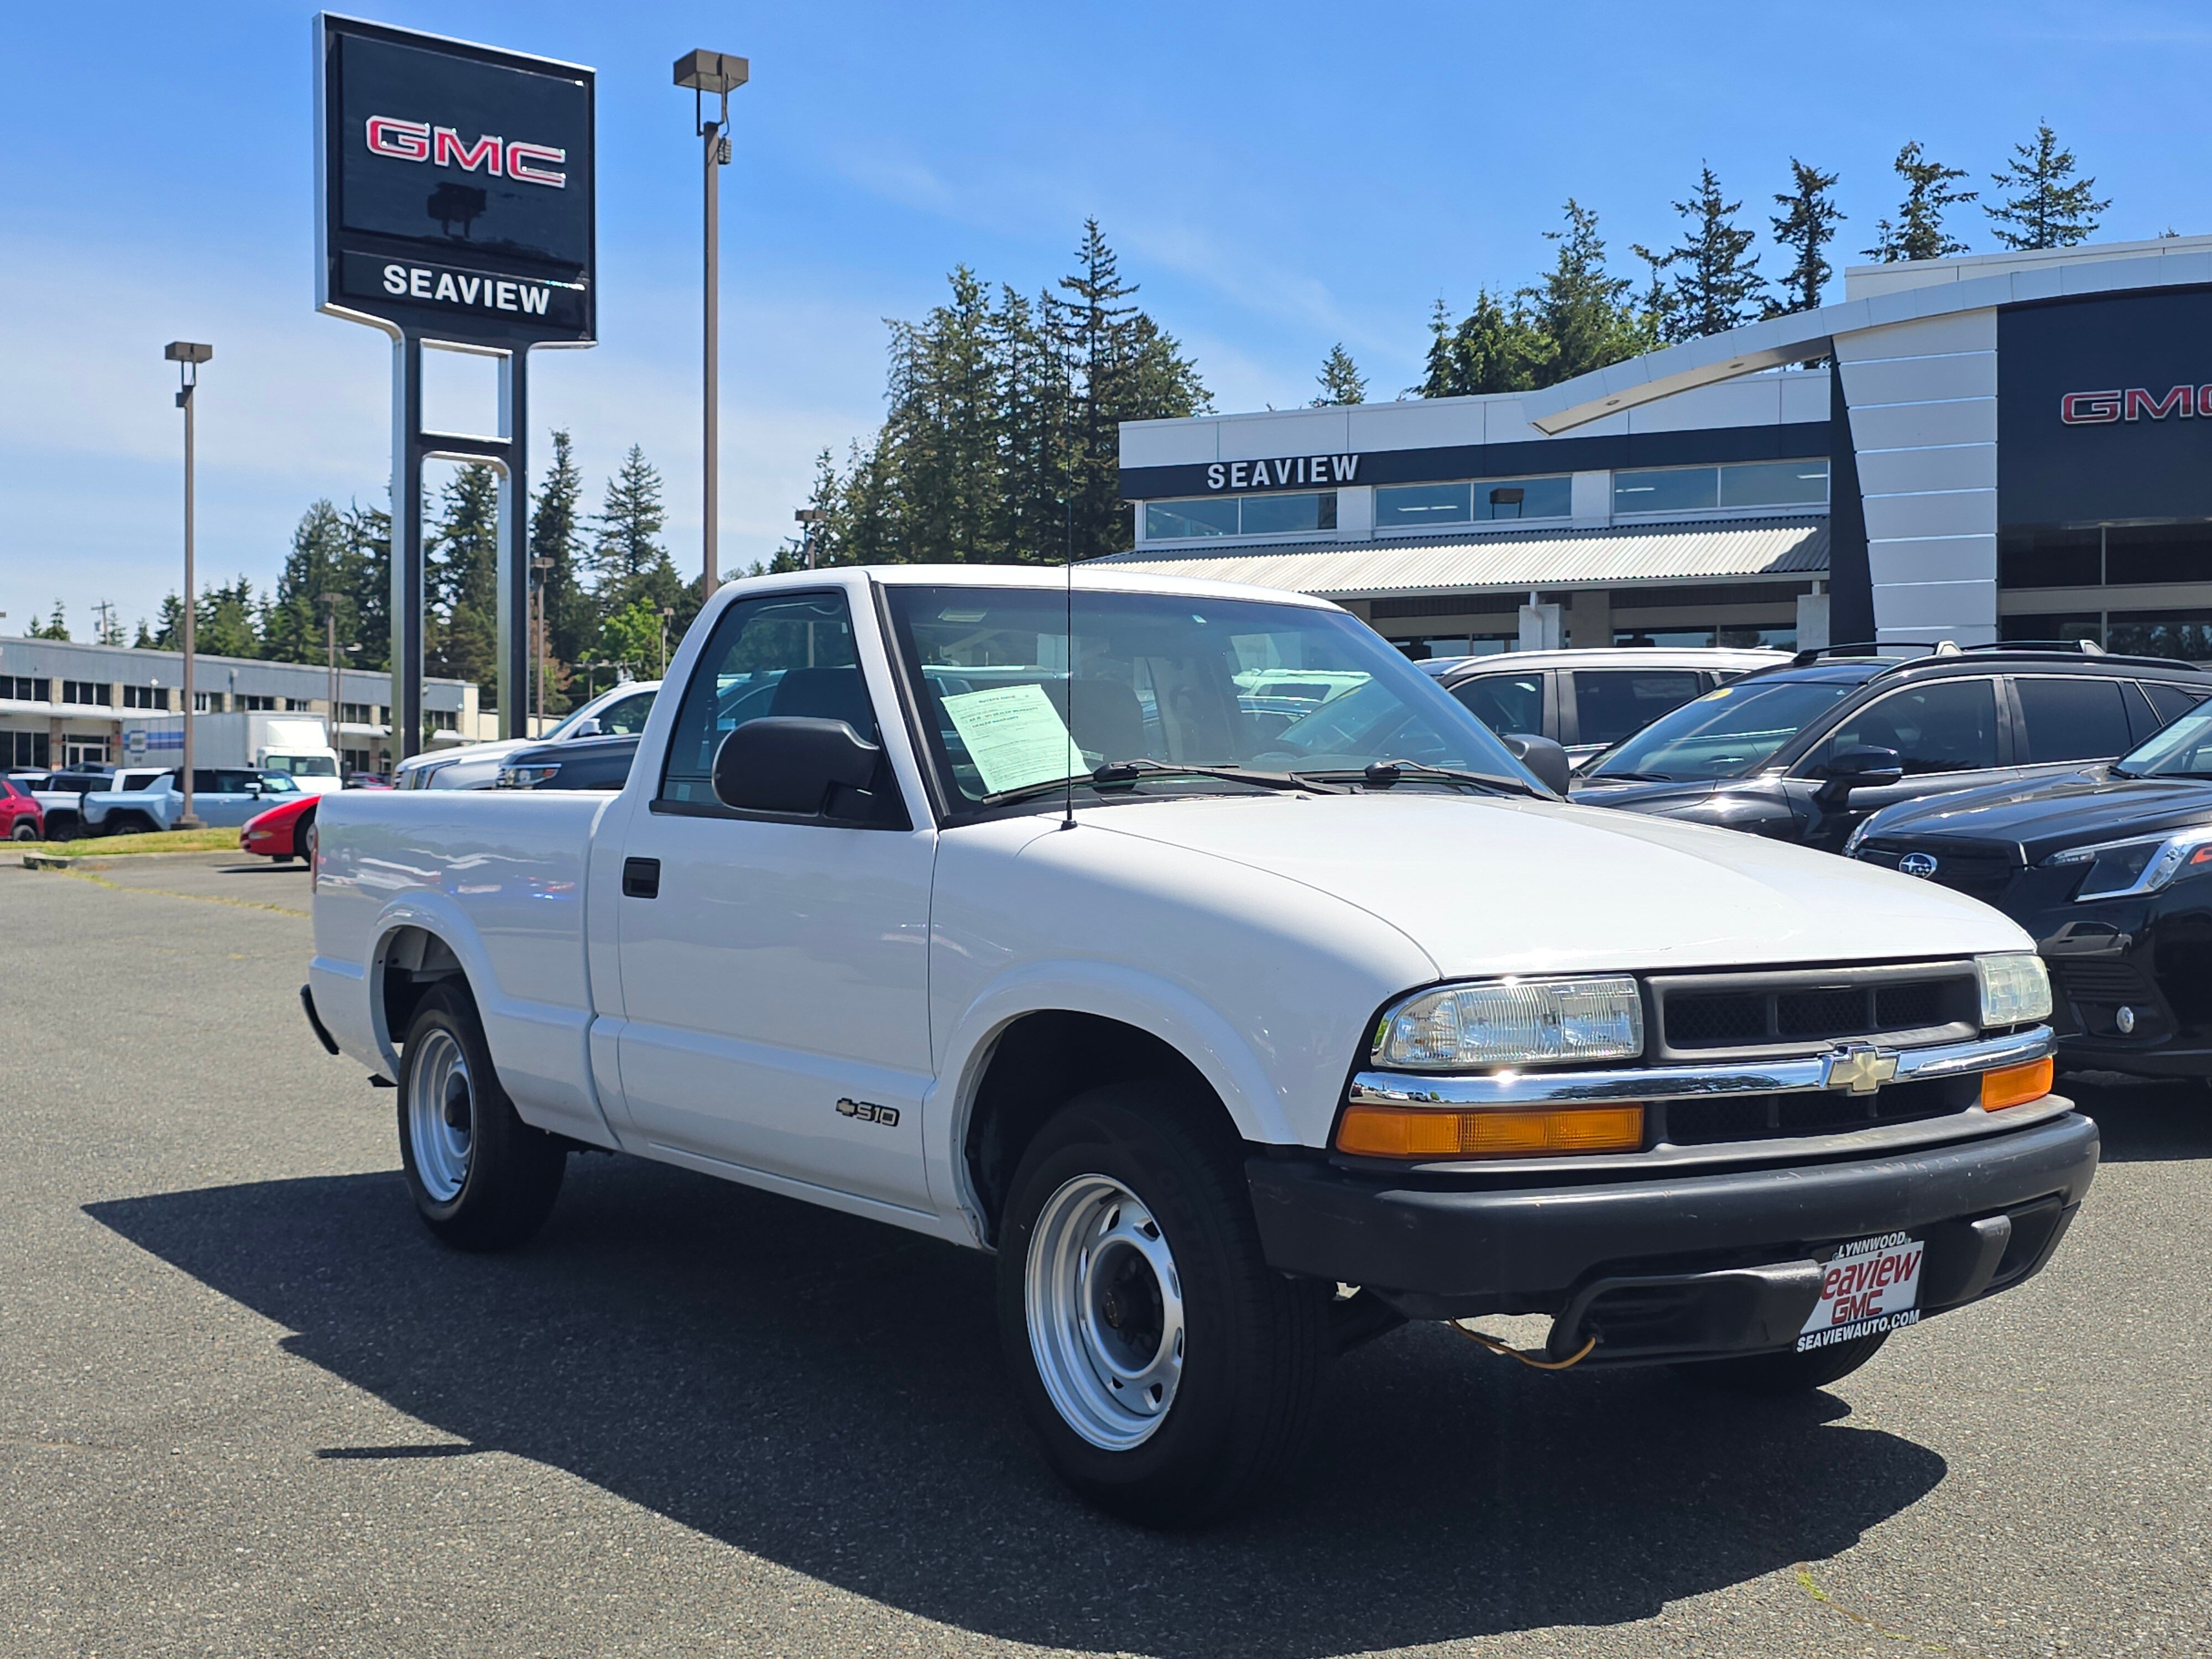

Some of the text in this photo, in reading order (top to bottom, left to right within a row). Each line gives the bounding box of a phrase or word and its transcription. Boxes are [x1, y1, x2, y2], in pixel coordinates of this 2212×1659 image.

[366, 114, 566, 189] GMC
[383, 264, 550, 315] SEAVIEW
[2061, 384, 2212, 425] GM
[1207, 455, 1359, 489] SEAVIEW
[857, 1101, 900, 1127] S10
[1837, 1231, 1906, 1259] LYNNWOOD
[1820, 1250, 1922, 1301] eaview
[1831, 1289, 1884, 1325] GMC
[1796, 1308, 1921, 1353] SEAVIEWAUTO.COM
